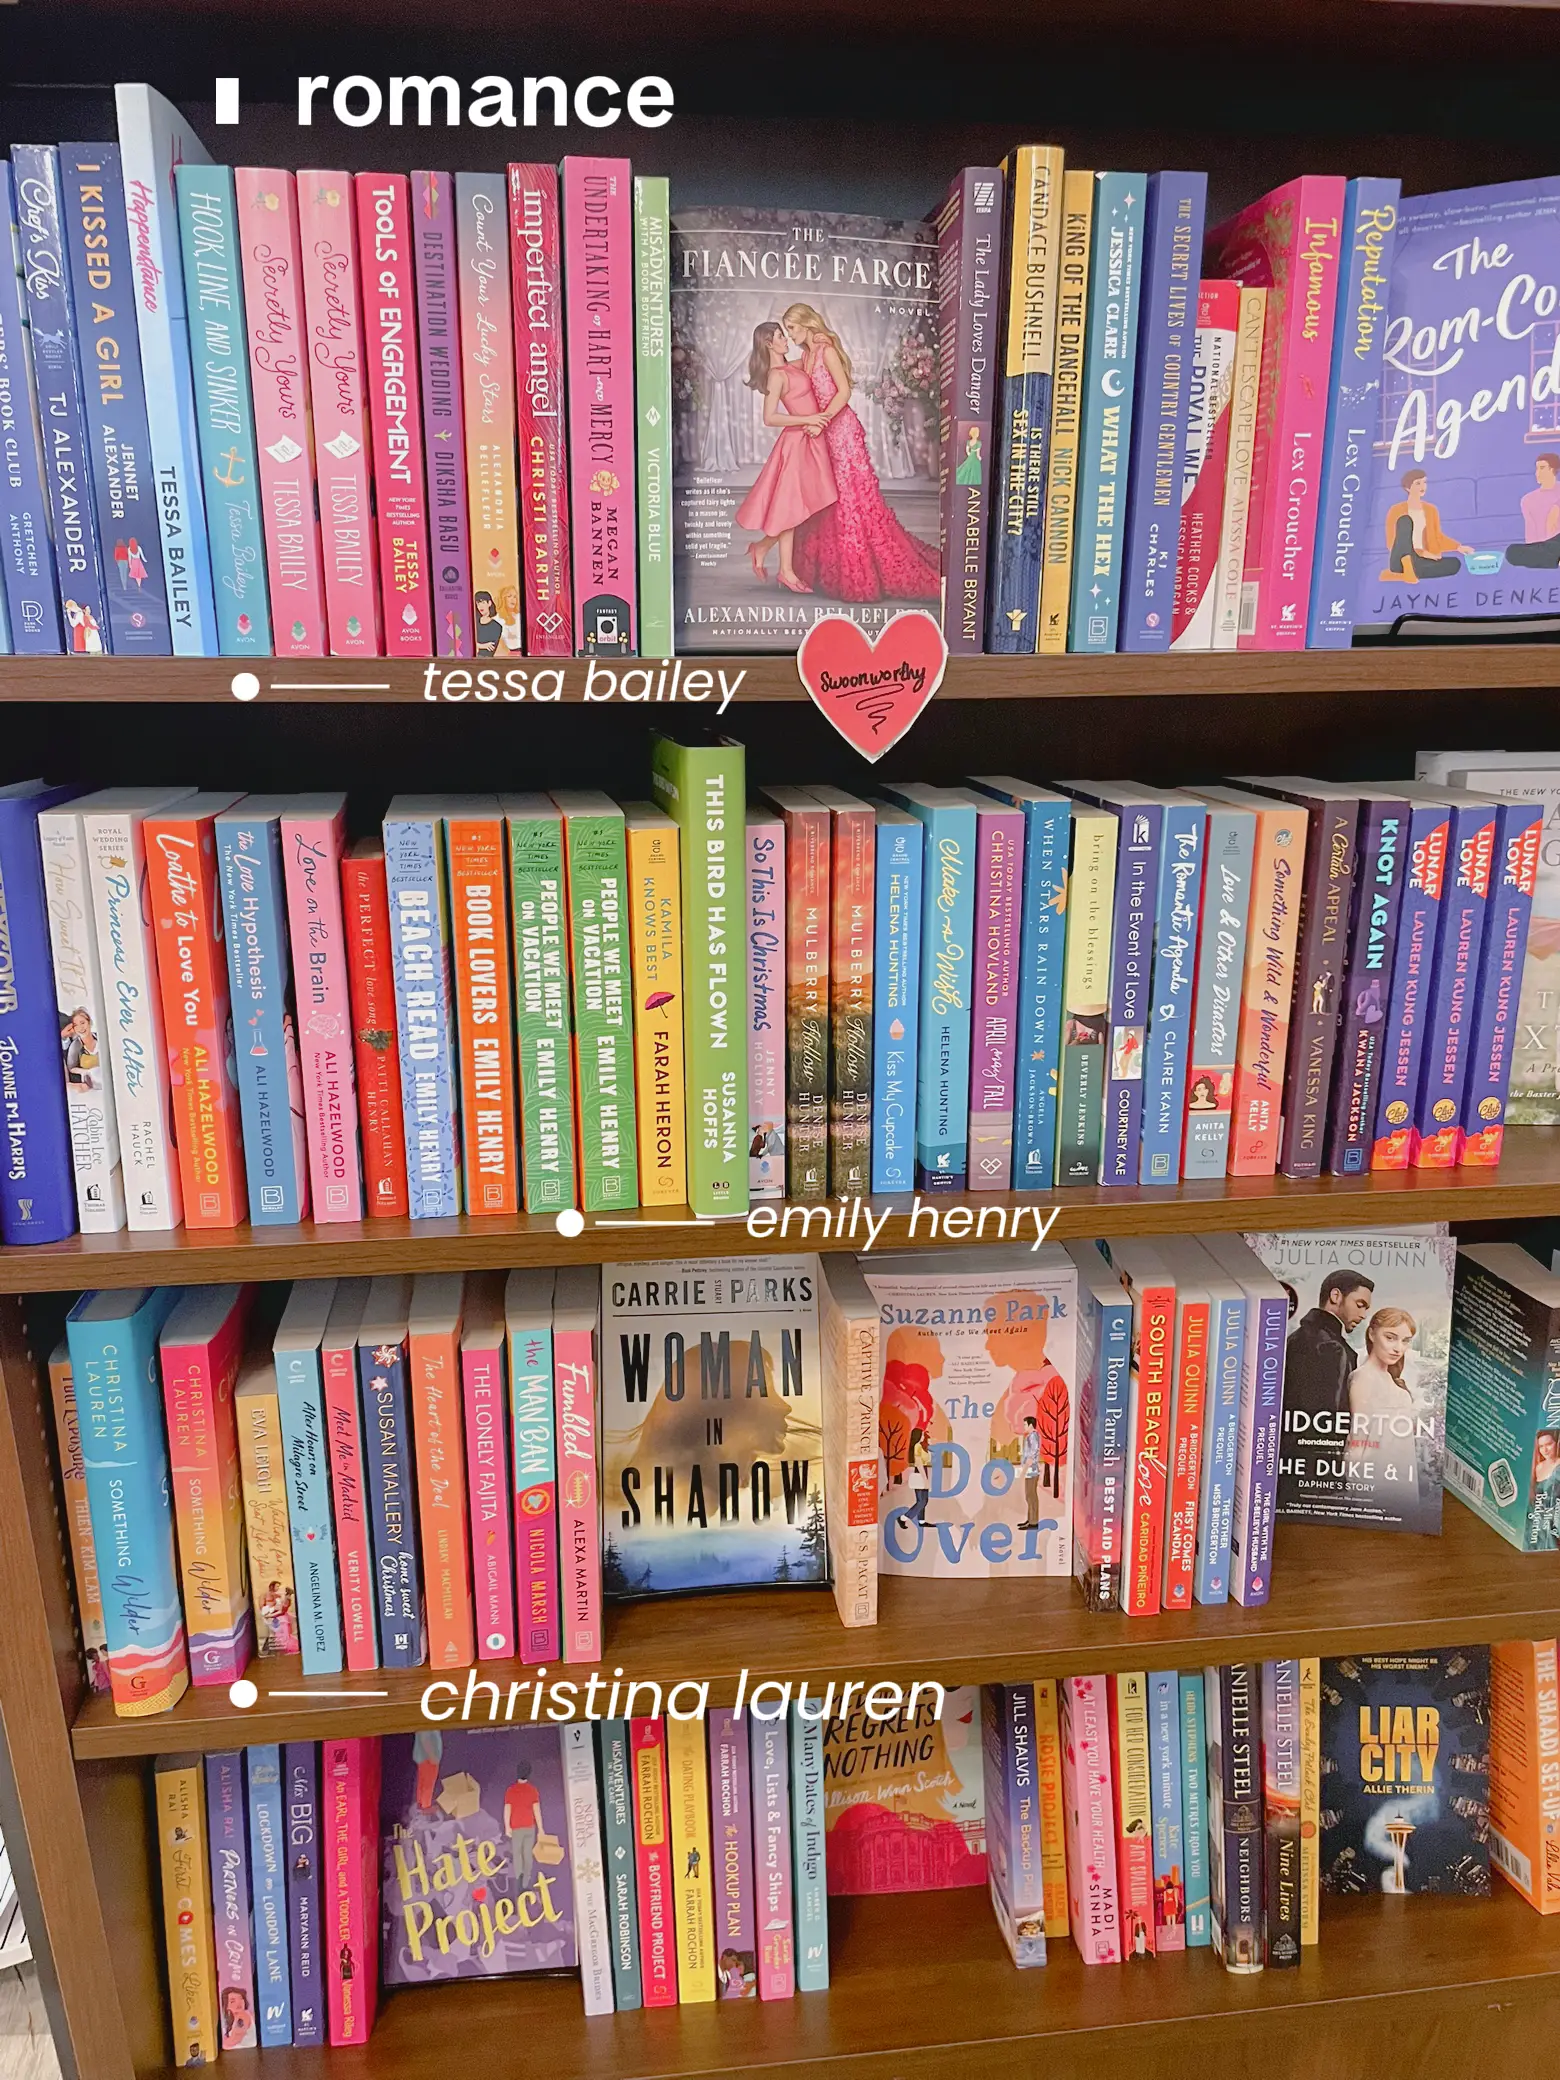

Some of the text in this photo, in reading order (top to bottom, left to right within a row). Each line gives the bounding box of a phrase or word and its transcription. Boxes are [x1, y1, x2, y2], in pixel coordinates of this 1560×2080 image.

[128, 180, 157, 313] Happenstance
[683, 247, 931, 289] FIANCÉE FARCE
[792, 227, 824, 243] THE
[1300, 219, 1337, 344] Infamous
[77, 164, 124, 406] I KISSED A GIRL
[190, 193, 242, 433] HOOK, LINE, AND SINKER
[523, 189, 556, 420] imperfect angel
[649, 216, 664, 358] MISADVENTURES
[889, 307, 931, 316] NOVEL
[1104, 226, 1125, 359] JESSICA CLARE
[1354, 206, 1396, 360] Reputation
[373, 186, 413, 484] TOOLS OF ENGAGEMENT
[49, 392, 88, 573] TJ ALEXANDER
[102, 425, 124, 519] ALEXANDER
[120, 443, 140, 502] JENNET
[530, 435, 548, 601] CHRISTI BARTH
[648, 448, 661, 563] VICTORIA BLUE
[1094, 406, 1120, 576] WHAT THE HEX
[1282, 433, 1311, 580] Lex Croucher
[160, 466, 192, 628] TESSA BAILEY
[391, 537, 408, 593] BAILEY
[404, 540, 418, 592] TESSA
[963, 487, 979, 641] ANABELLE BRYANT
[1145, 523, 1159, 598] CHARLES
[1157, 550, 1167, 568] KJ
[684, 607, 807, 623] ALEXANDRIA
[820, 661, 926, 692] Swoonworthy
[1366, 819, 1399, 969] KNOT AGAIN
[1409, 841, 1426, 889] LOVE
[1424, 833, 1442, 896] LUNAR
[157, 832, 198, 1026] Loathe to Love You
[233, 831, 263, 999] the Love Hypothesis
[466, 885, 497, 1025] BOOK LOVERS
[583, 900, 602, 1012] ON VACATION
[706, 775, 728, 1048] THIS BIRD HAS FLOWN
[106, 875, 144, 1098] Princess Ever After
[397, 891, 436, 1060] BEACH READ
[1394, 911, 1426, 1087] LAUREN KUNG JESSEN
[472, 1038, 504, 1176] EMILY HENRY
[654, 1031, 672, 1169] FARAH HERON
[703, 1088, 717, 1149] HOFFS
[721, 1071, 737, 1164] SUSANNA
[1158, 1031, 1175, 1134] CLAIRE KANN
[1195, 1123, 1225, 1131] ANITA
[1116, 1090, 1130, 1176] COURTNEY KAE
[1195, 1133, 1224, 1142] KELLY
[1275, 1249, 1426, 1267] JULIA QUINN
[1367, 1241, 1420, 1249] BESTSELLER
[612, 1280, 706, 1307] CARRIE
[731, 1277, 812, 1303] PARKS
[880, 1296, 1068, 1325] Suzanne Park
[86, 1361, 106, 1438] LAUREN
[103, 1344, 126, 1453] CHRISTINA
[558, 1362, 591, 1460] Fumbled
[620, 1329, 802, 1402] WOMAN
[944, 1395, 994, 1420] The
[375, 1392, 405, 1545] SUSAN MALLERY
[473, 1364, 498, 1523] THE LONELY FAJITA
[706, 1418, 723, 1445] IN
[927, 1442, 1016, 1499] Do
[621, 1460, 809, 1531] SHADOW
[1298, 1480, 1342, 1490] DAPHNE'S
[109, 1479, 151, 1636] SOMETHING Wilder
[573, 1519, 589, 1622] ALEXA MARTIN
[883, 1506, 1059, 1565] Over
[824, 1735, 934, 1781] NOTHING
[1013, 1693, 1030, 1786] JILL SHALVIS
[1359, 1706, 1439, 1744] LIAR
[1360, 1745, 1439, 1782] CITY
[765, 1731, 782, 1912] Love, Lists & Fancy Ships
[1363, 1785, 1435, 1794] ALLIE THERIN
[394, 1834, 507, 1901] Hate
[725, 1841, 741, 1937] HOOKUP PLAN
[1090, 1884, 1101, 1936] SINHA
[1102, 1888, 1114, 1931] MADI
[1240, 1837, 1251, 1923] NEIGHBORS
[403, 1872, 563, 1962] Project
[616, 1874, 631, 1970] SARAH ROBINSON
